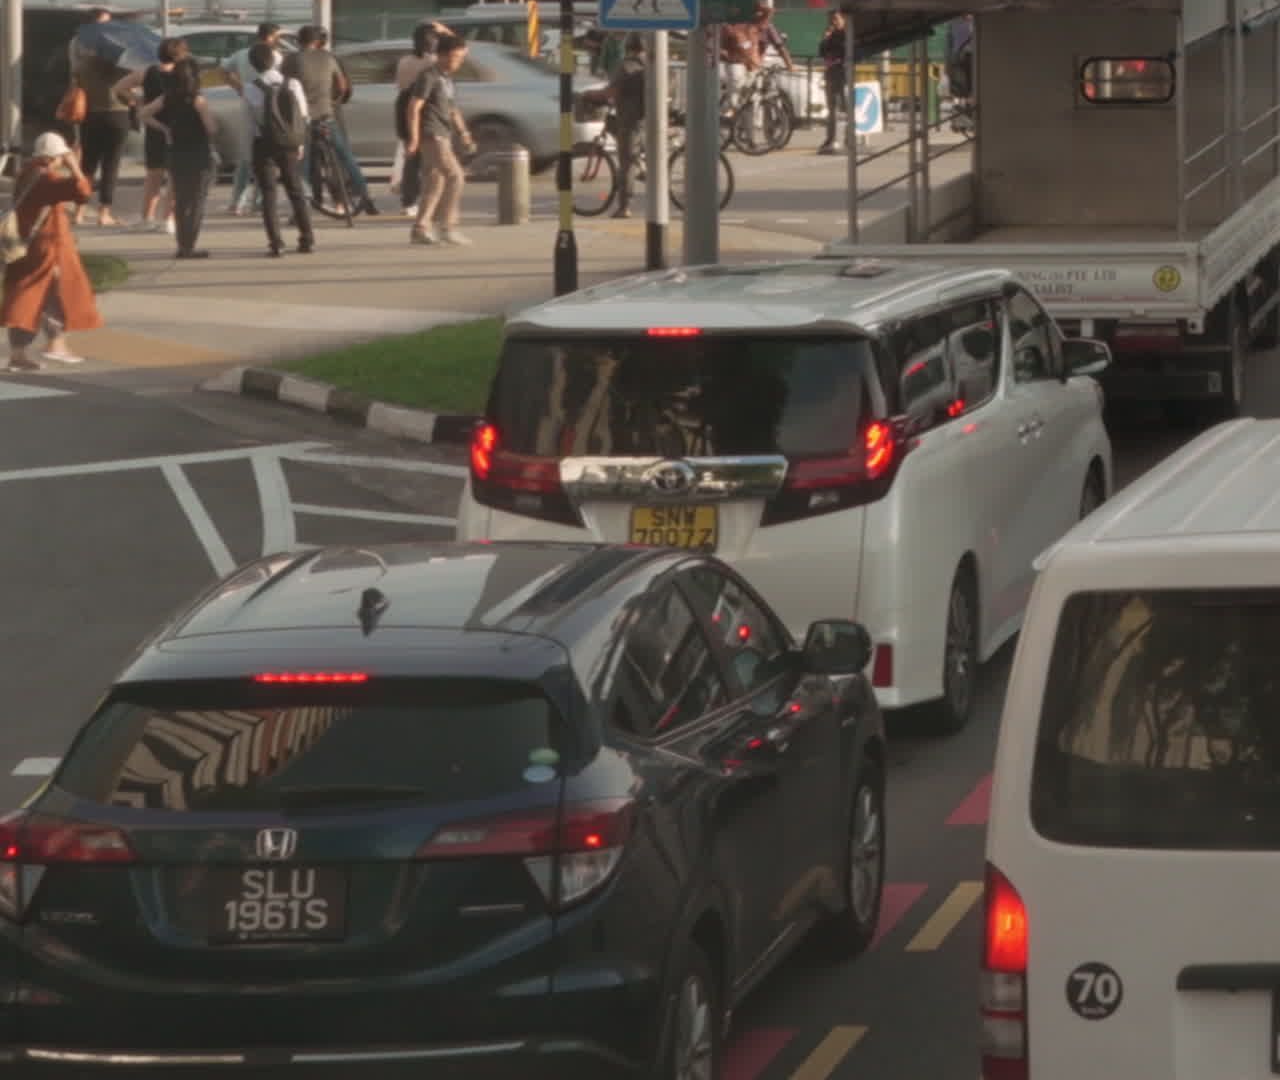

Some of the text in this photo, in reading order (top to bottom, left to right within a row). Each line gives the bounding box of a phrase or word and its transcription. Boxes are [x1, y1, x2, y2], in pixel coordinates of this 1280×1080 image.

[652, 506, 696, 528] SNW
[241, 868, 316, 900] SLU
[224, 897, 329, 931] 1961S
[1073, 972, 1119, 1004] 70
